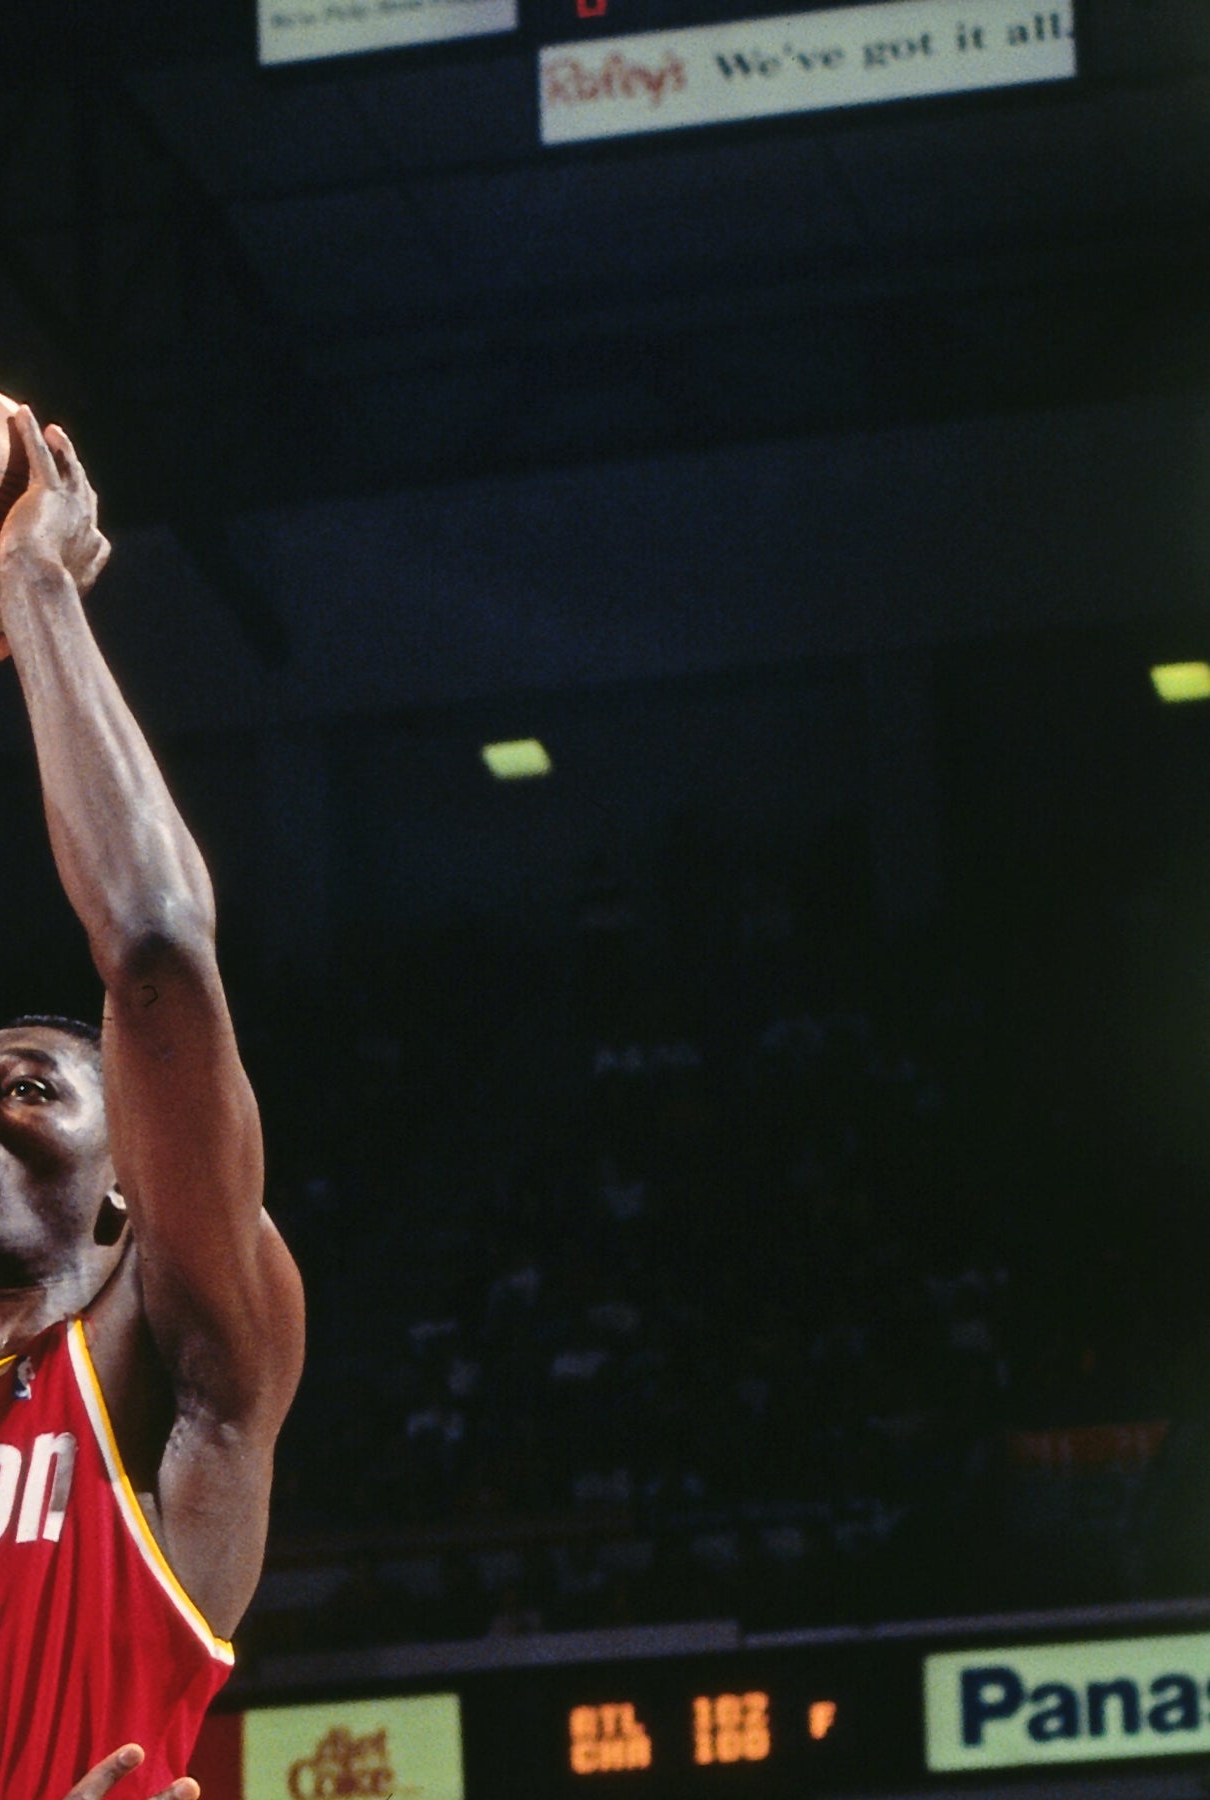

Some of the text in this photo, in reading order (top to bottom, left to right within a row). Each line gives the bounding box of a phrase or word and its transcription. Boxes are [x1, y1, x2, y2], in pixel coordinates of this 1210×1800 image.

[714, 41, 845, 81] We've
[861, 33, 933, 70] got
[956, 20, 985, 51] it
[960, 1664, 1210, 1747] Pana
